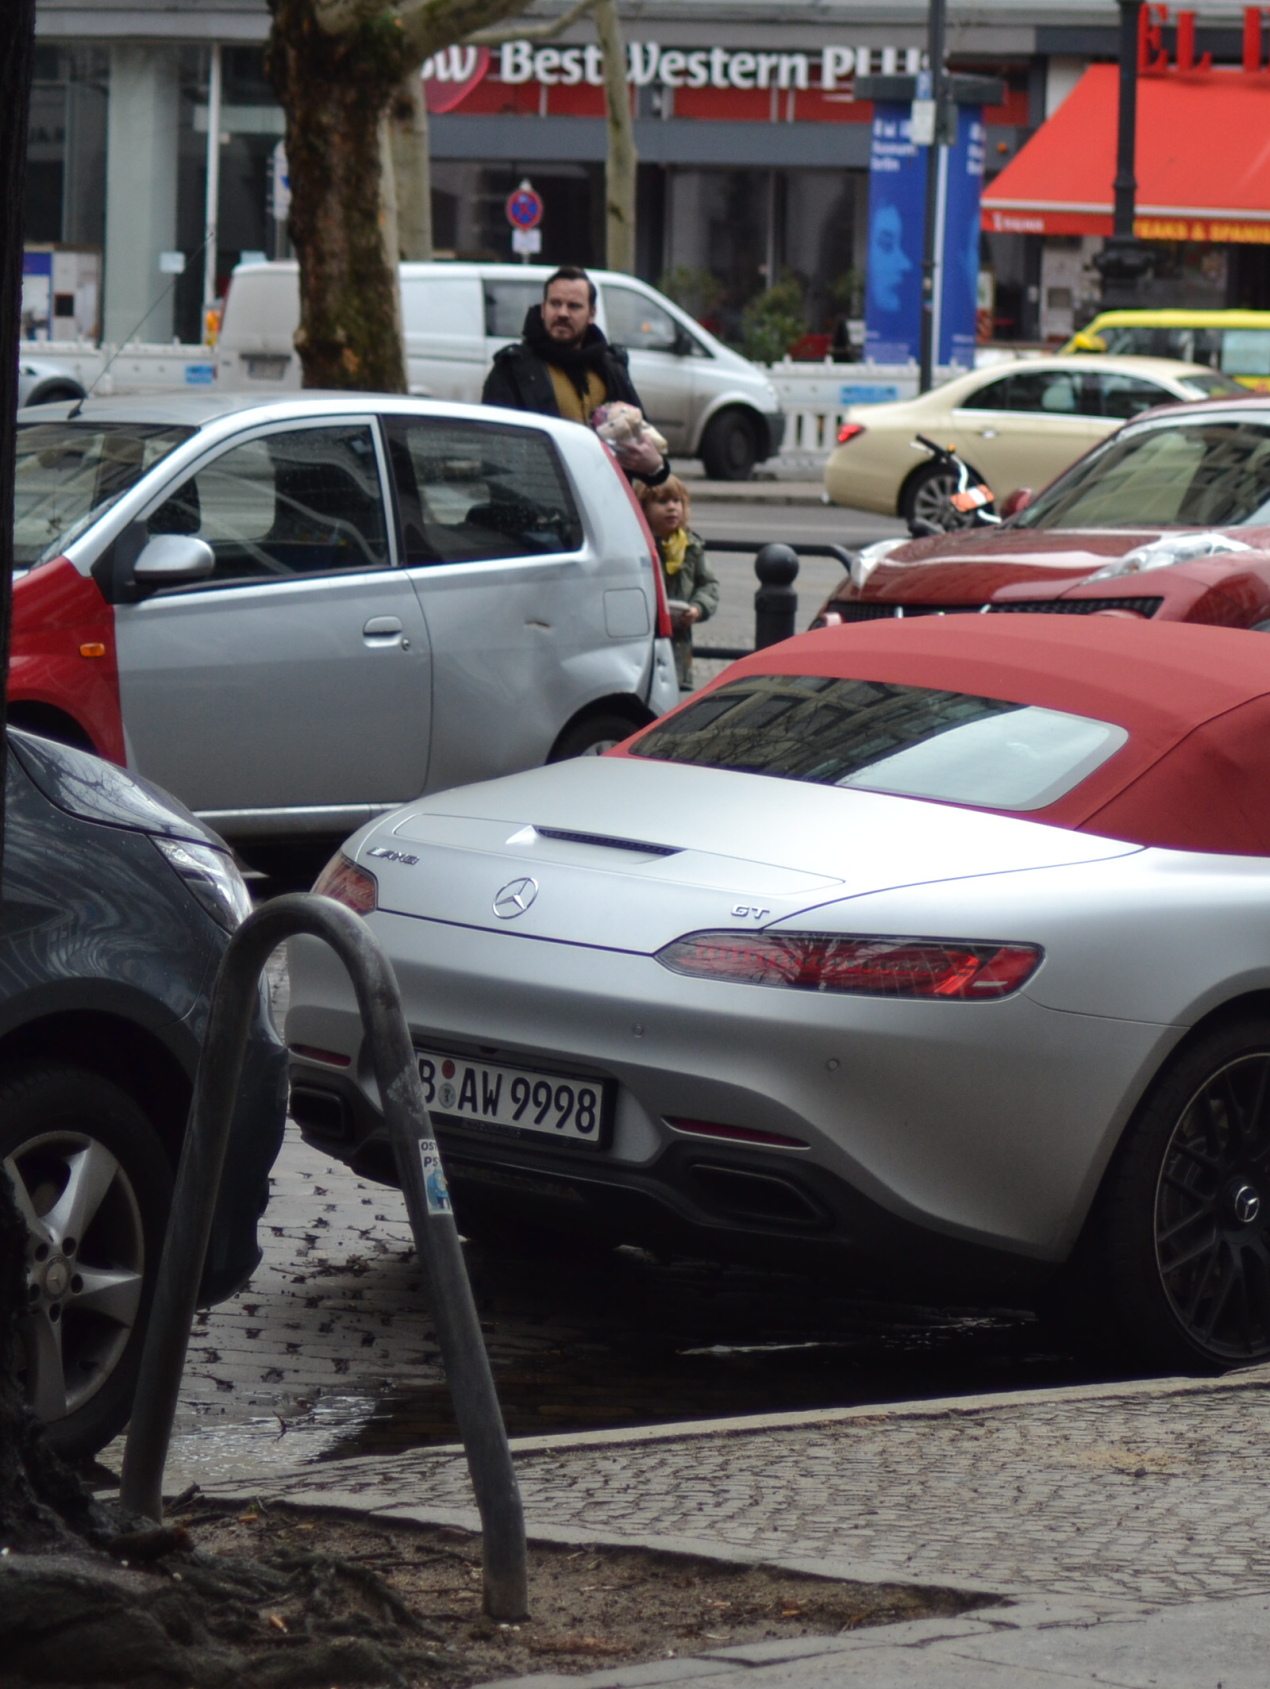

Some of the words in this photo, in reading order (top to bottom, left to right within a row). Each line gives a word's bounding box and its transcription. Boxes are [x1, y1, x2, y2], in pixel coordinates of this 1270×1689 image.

[1137, 3, 1213, 73] EL
[501, 40, 605, 85] Best
[626, 41, 809, 90] Western
[367, 847, 420, 866] AMG
[731, 905, 770, 920] GT
[418, 1058, 436, 1104] B
[457, 1067, 504, 1117] AW
[510, 1076, 597, 1134] 9998
